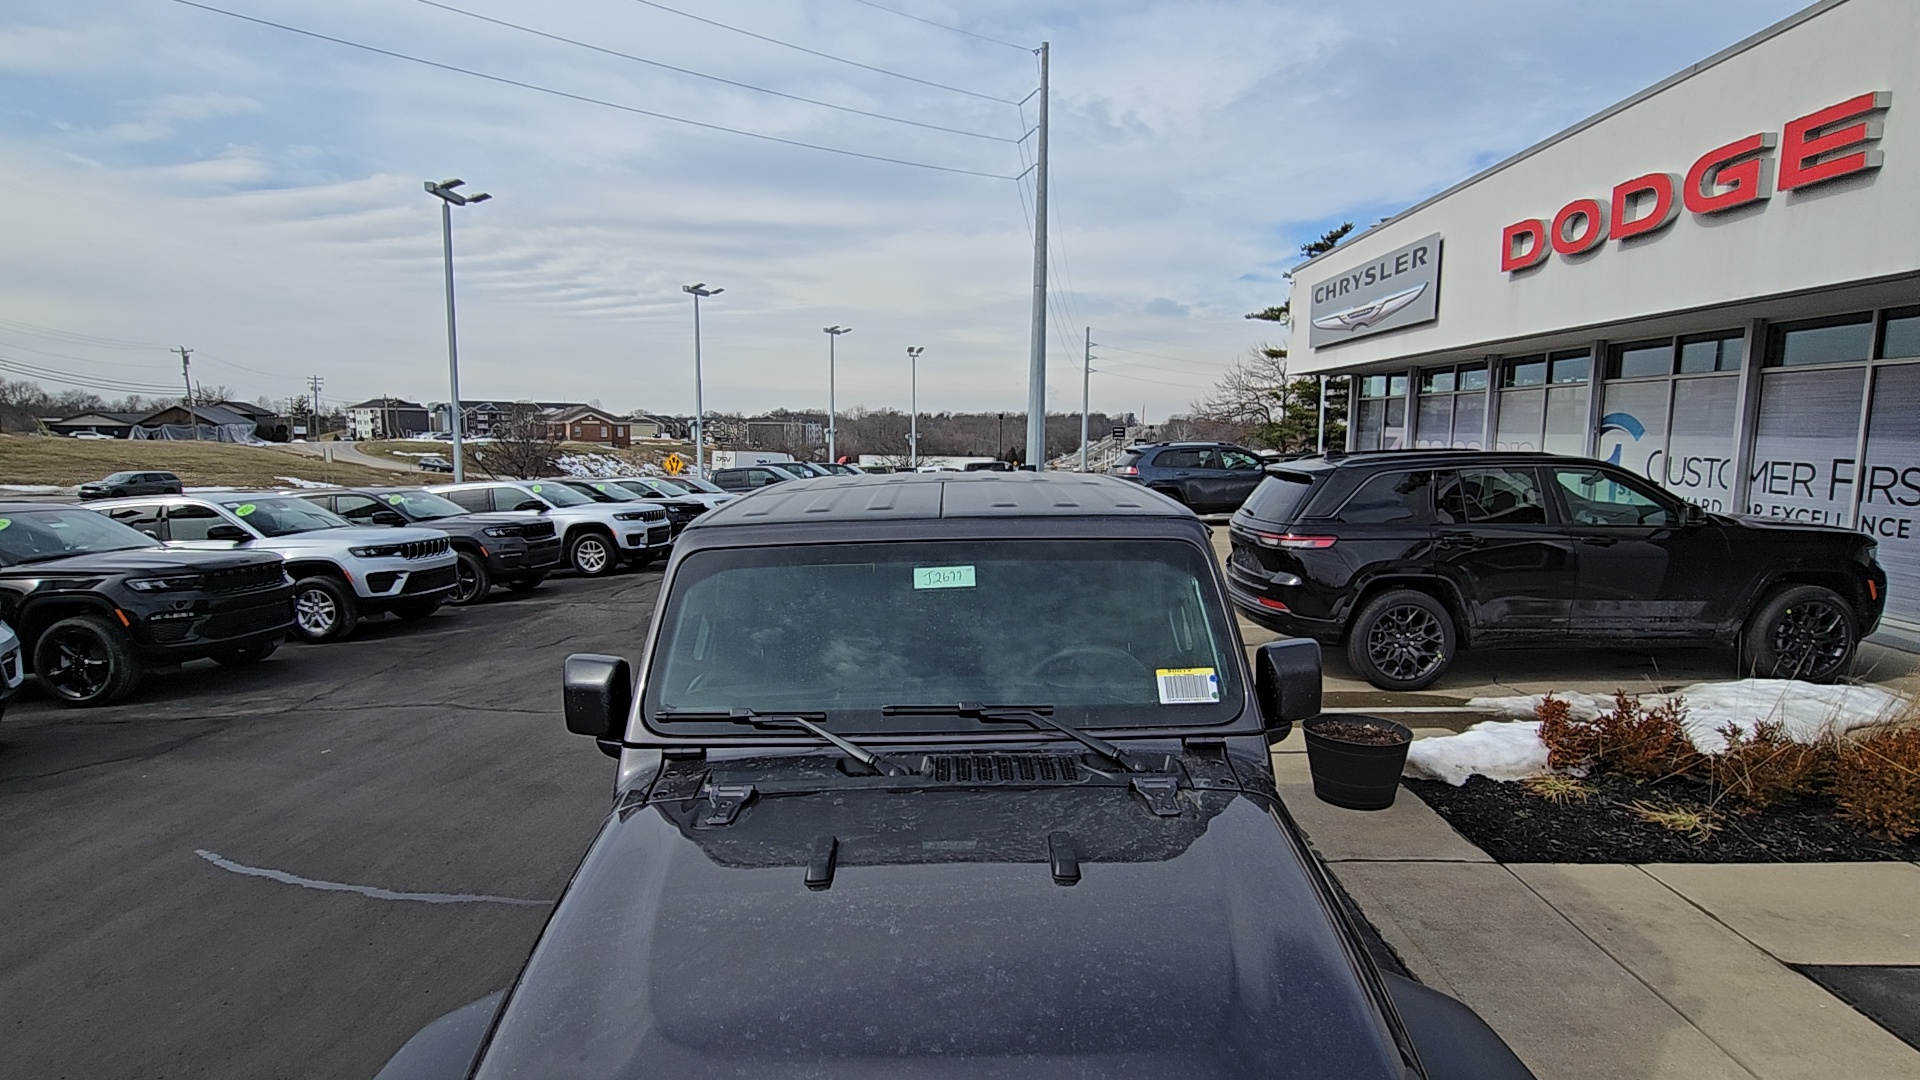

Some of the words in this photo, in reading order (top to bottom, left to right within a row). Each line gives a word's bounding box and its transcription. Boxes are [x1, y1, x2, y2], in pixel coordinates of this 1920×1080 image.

[1501, 91, 1892, 272] DODGE
[1314, 246, 1428, 304] CHRYSLER
[1771, 505, 1912, 539] EXCELLNCE
